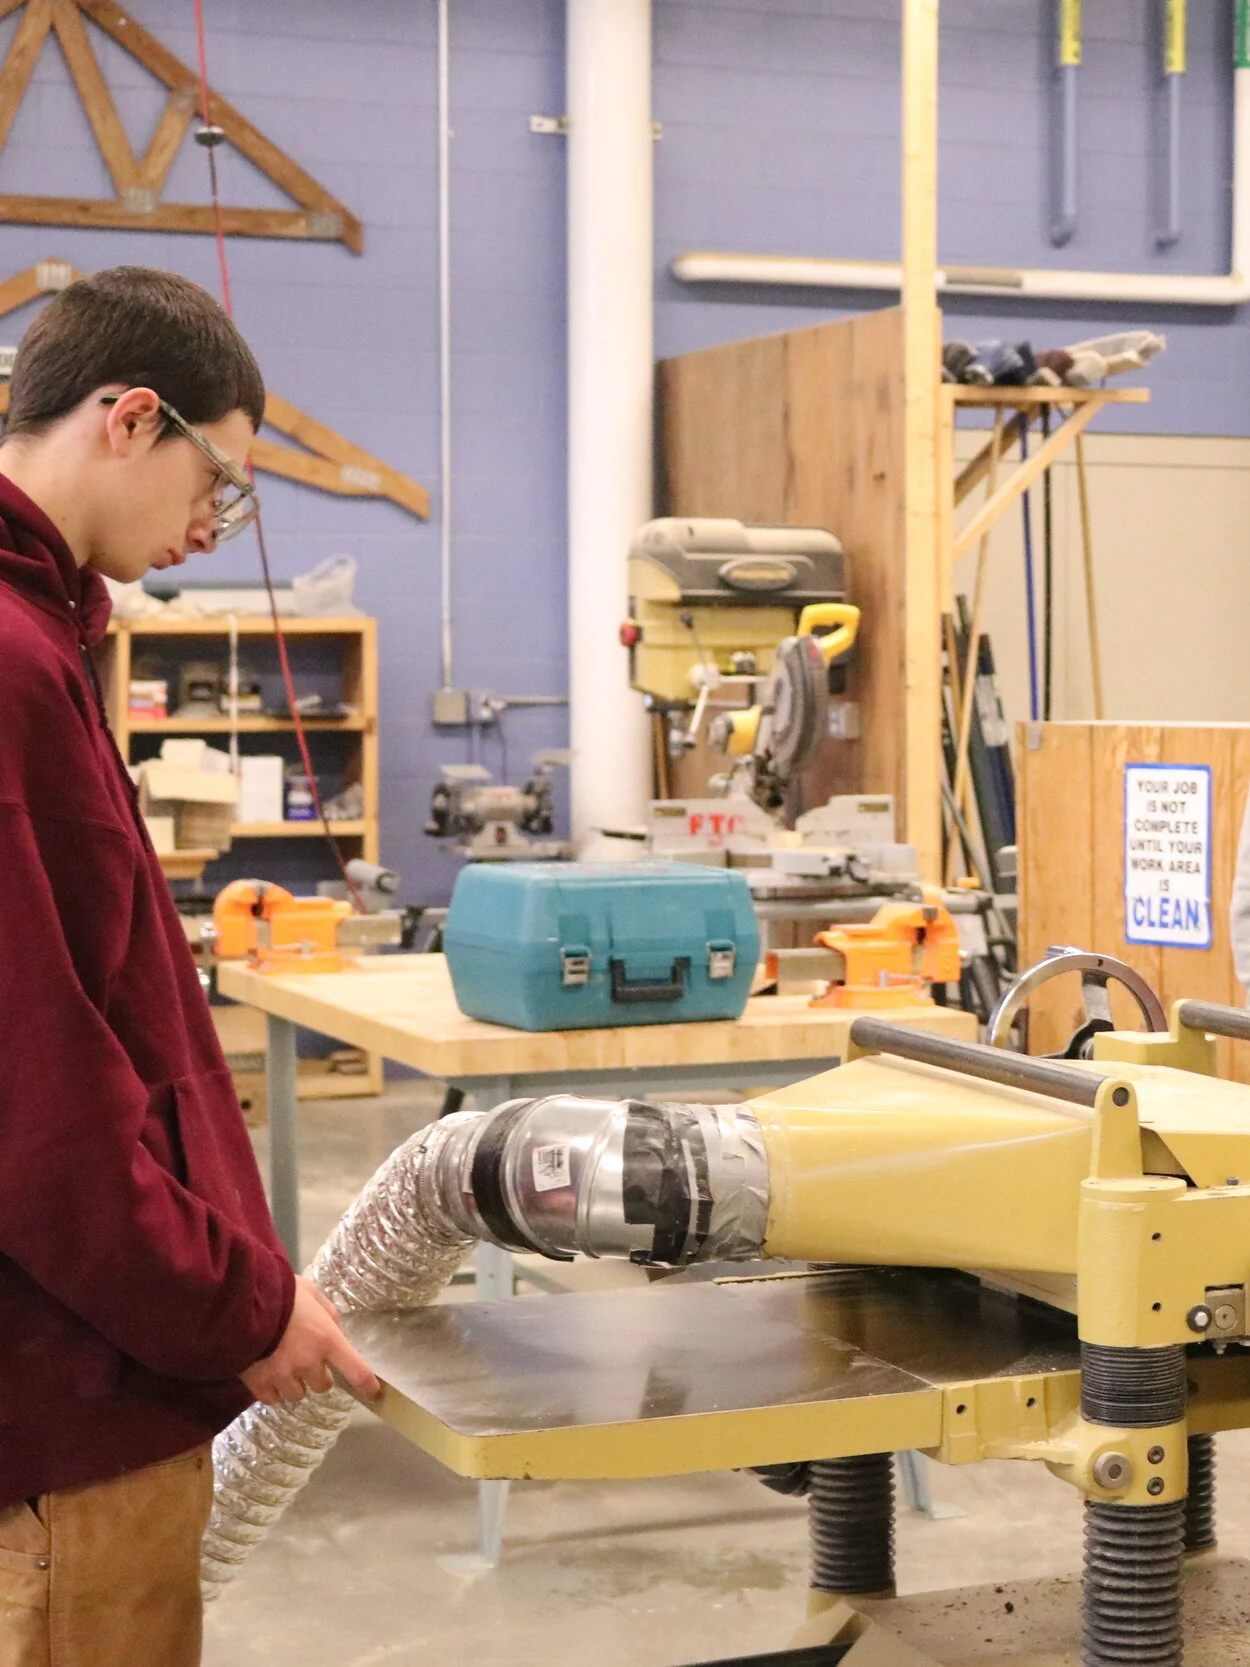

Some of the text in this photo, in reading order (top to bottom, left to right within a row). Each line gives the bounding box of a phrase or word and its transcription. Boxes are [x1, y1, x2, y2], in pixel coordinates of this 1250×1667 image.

[1137, 779, 1198, 794] YOUR JOB
[1147, 800, 1186, 814] IS NOT
[1134, 818, 1198, 834] COMPLETE
[1130, 838, 1202, 854] UNTIL YOUR
[1131, 858, 1201, 874] WORK AREA
[1159, 879, 1169, 892] IS
[1133, 896, 1199, 930] CLEAN
